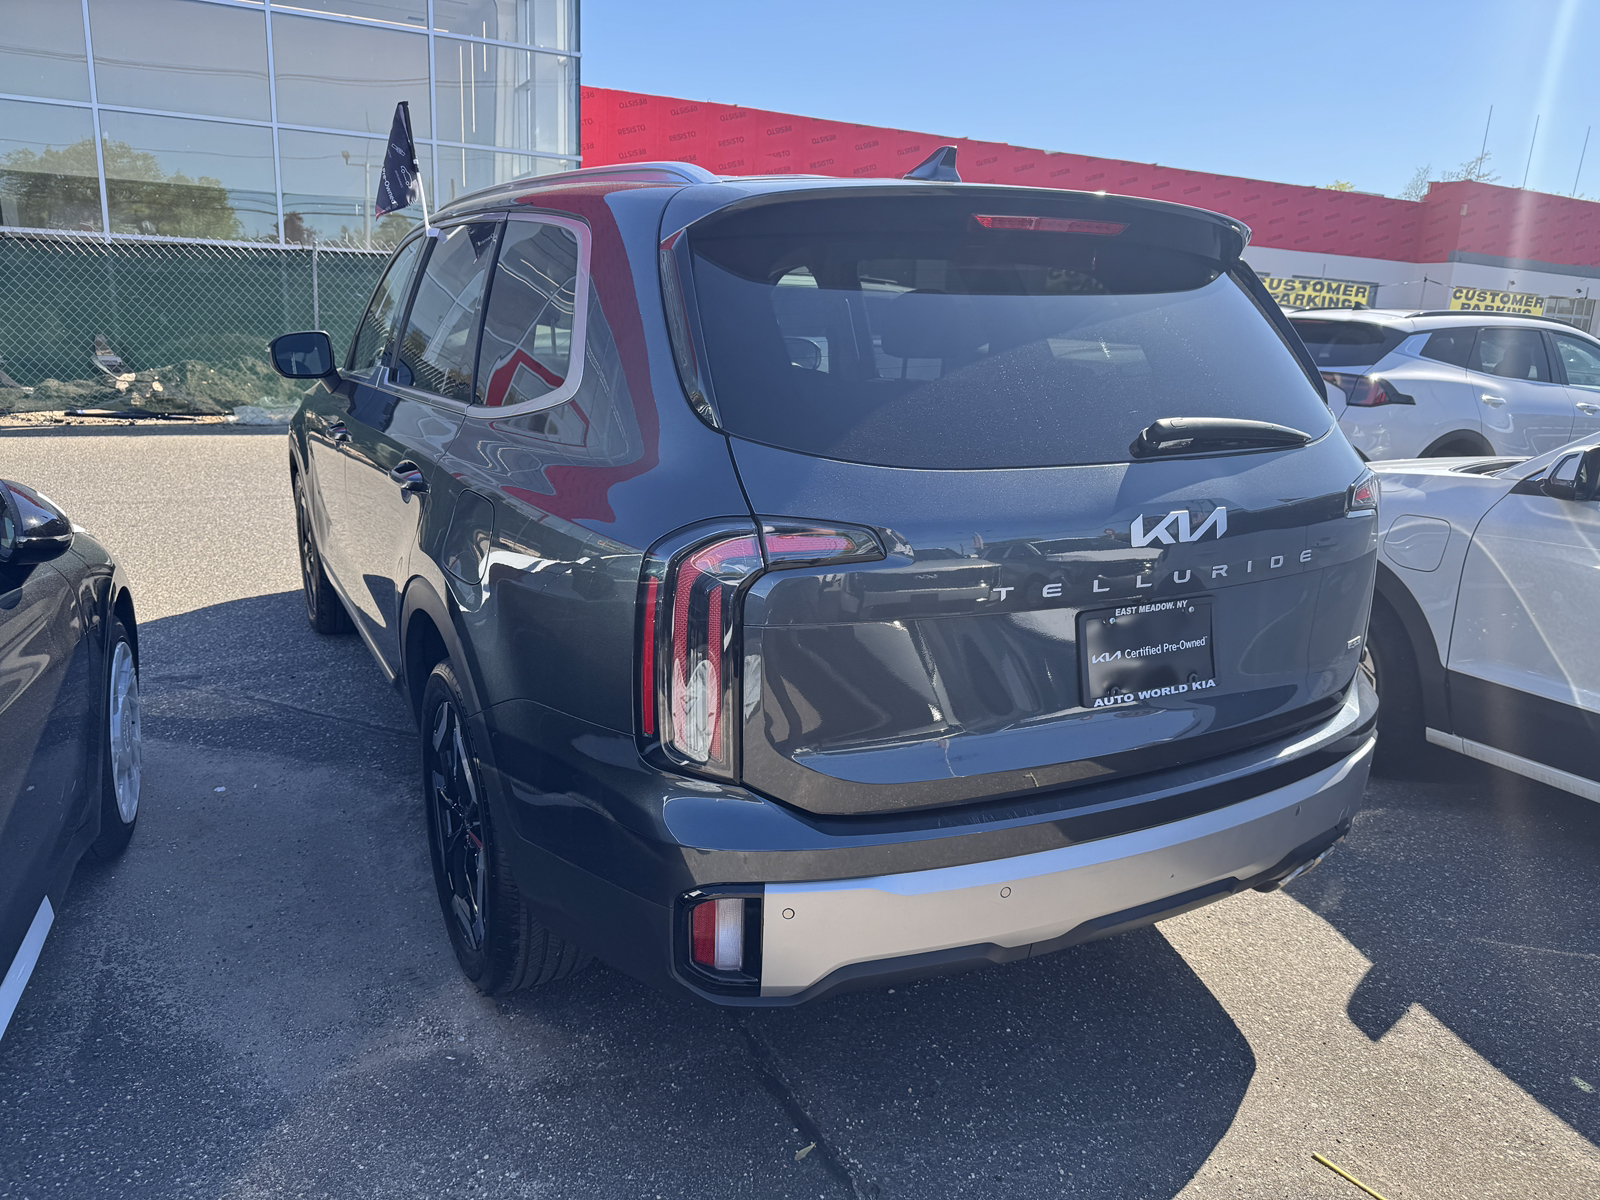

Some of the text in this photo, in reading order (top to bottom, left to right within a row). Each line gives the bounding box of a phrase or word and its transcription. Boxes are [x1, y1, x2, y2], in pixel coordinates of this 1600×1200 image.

[619, 98, 648, 109] RESISTO
[670, 105, 698, 116] RESISTO
[618, 124, 646, 135] RESISTO
[669, 131, 697, 142] RESISTO
[718, 136, 745, 147] RESISTO
[619, 148, 647, 159] RESISTO
[1453, 288, 1545, 309] CUSTOMER
[1130, 506, 1228, 547] KIA
[993, 549, 1312, 602] TELLURIDE
[1115, 607, 1137, 617] EAST
[1177, 600, 1188, 609] NY
[1125, 645, 1162, 659] Certified
[1093, 679, 1216, 708] AUTO WORLD KIA
